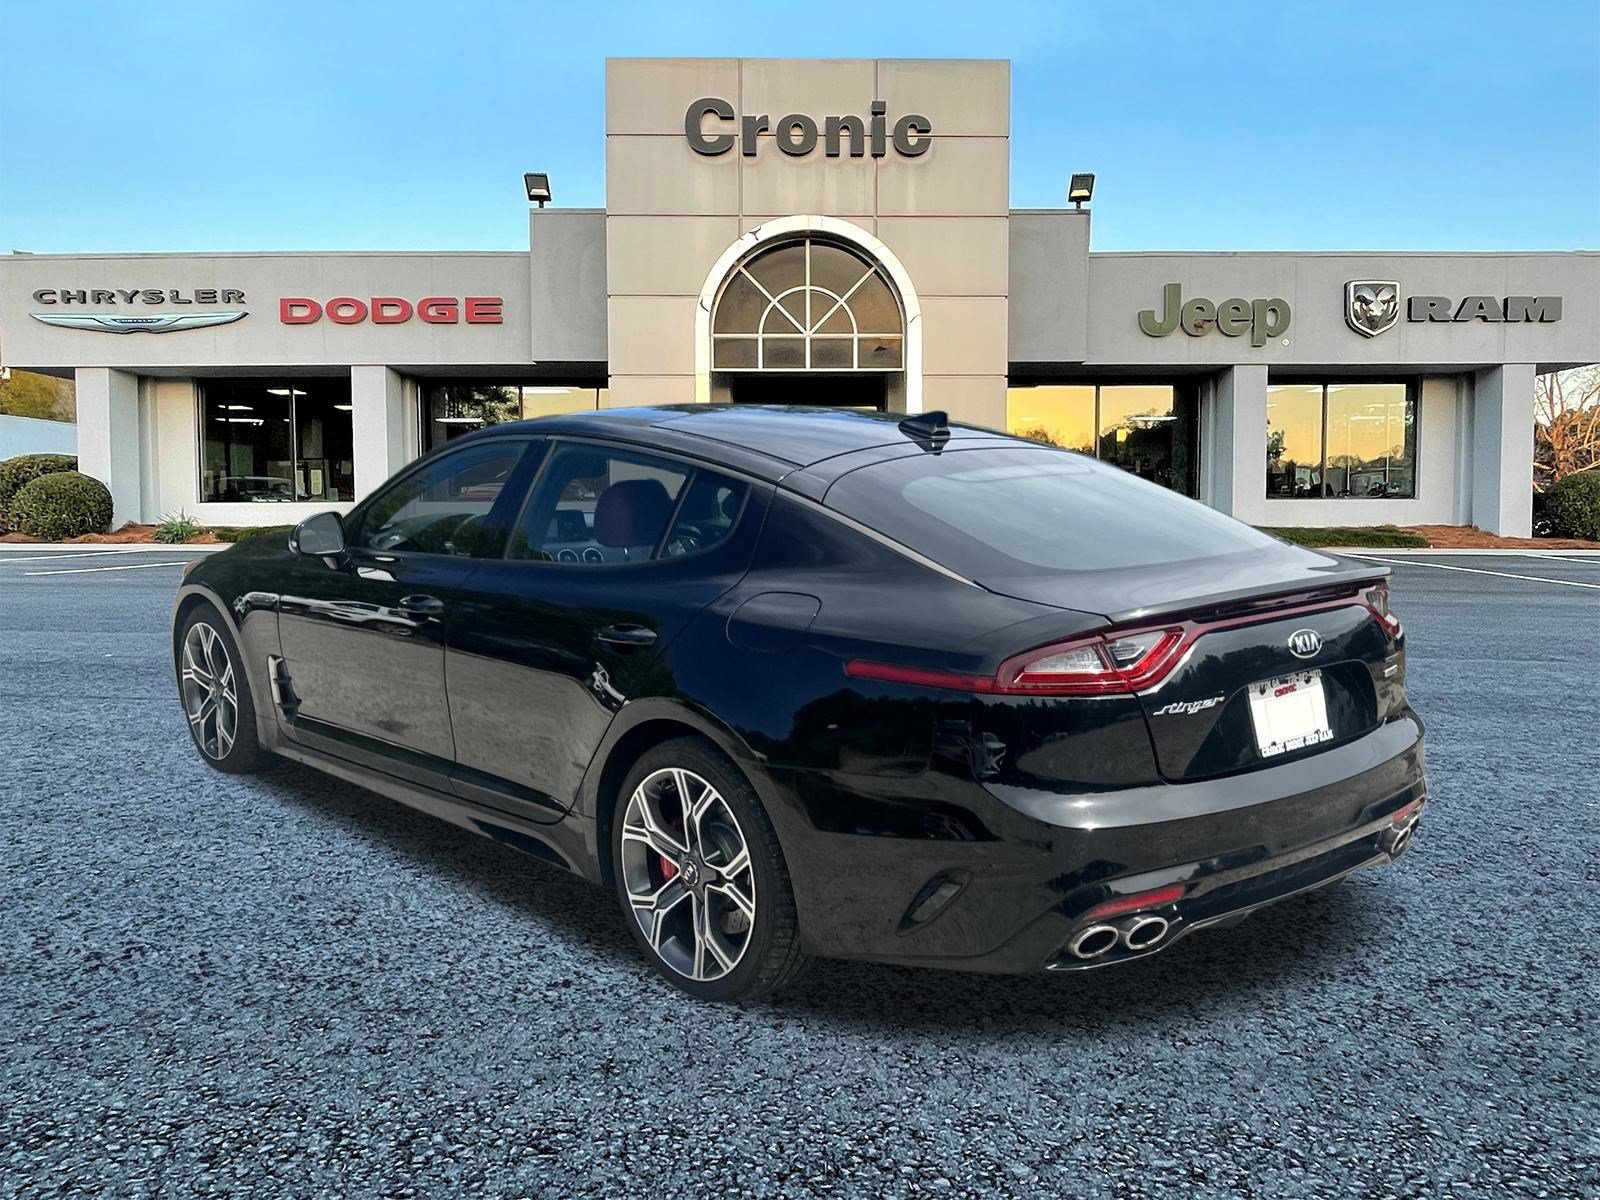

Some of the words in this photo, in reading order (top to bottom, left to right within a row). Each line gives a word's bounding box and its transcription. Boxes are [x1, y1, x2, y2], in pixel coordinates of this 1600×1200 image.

[685, 97, 932, 158] Cronic
[32, 289, 248, 305] CHRYSLER
[1407, 296, 1563, 323] RAM
[279, 297, 504, 325] DODGE
[1138, 283, 1291, 347] Jeep
[1294, 633, 1320, 653] KIA
